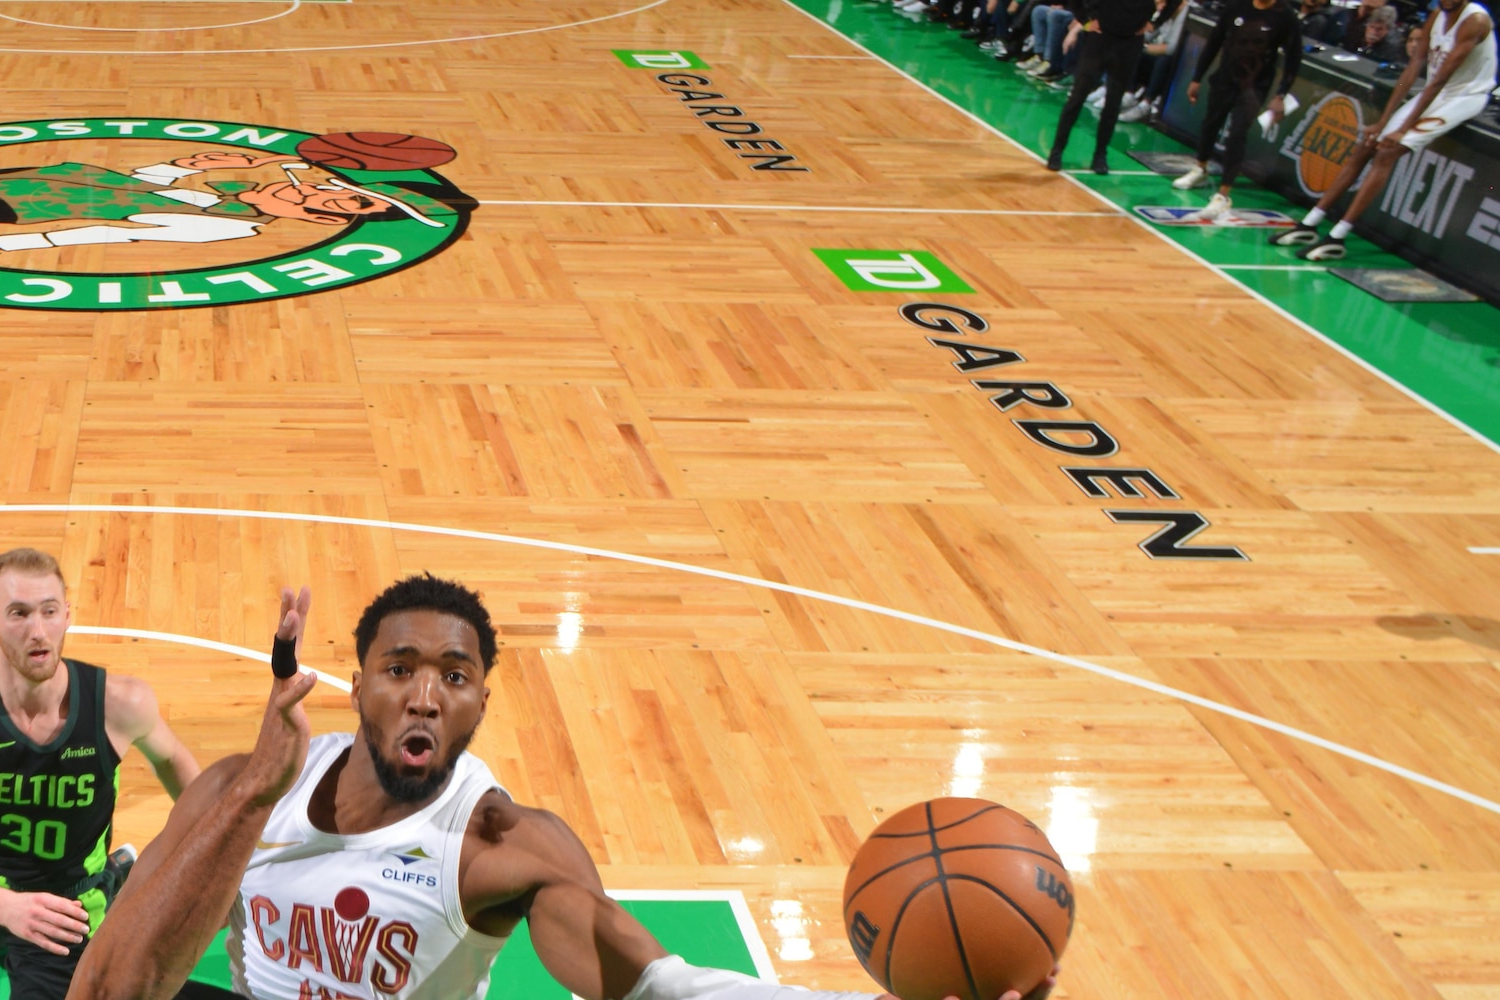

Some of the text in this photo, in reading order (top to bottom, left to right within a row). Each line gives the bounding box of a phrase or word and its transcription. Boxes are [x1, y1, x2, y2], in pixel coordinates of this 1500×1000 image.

[655, 73, 812, 173] GARDEN
[1381, 148, 1475, 239] NEXT
[897, 302, 1252, 561] GARDEN
[60, 746, 96, 760] Amica
[0, 813, 67, 860] 30
[381, 867, 437, 887] CLIFFS
[250, 886, 419, 995] CAVS
